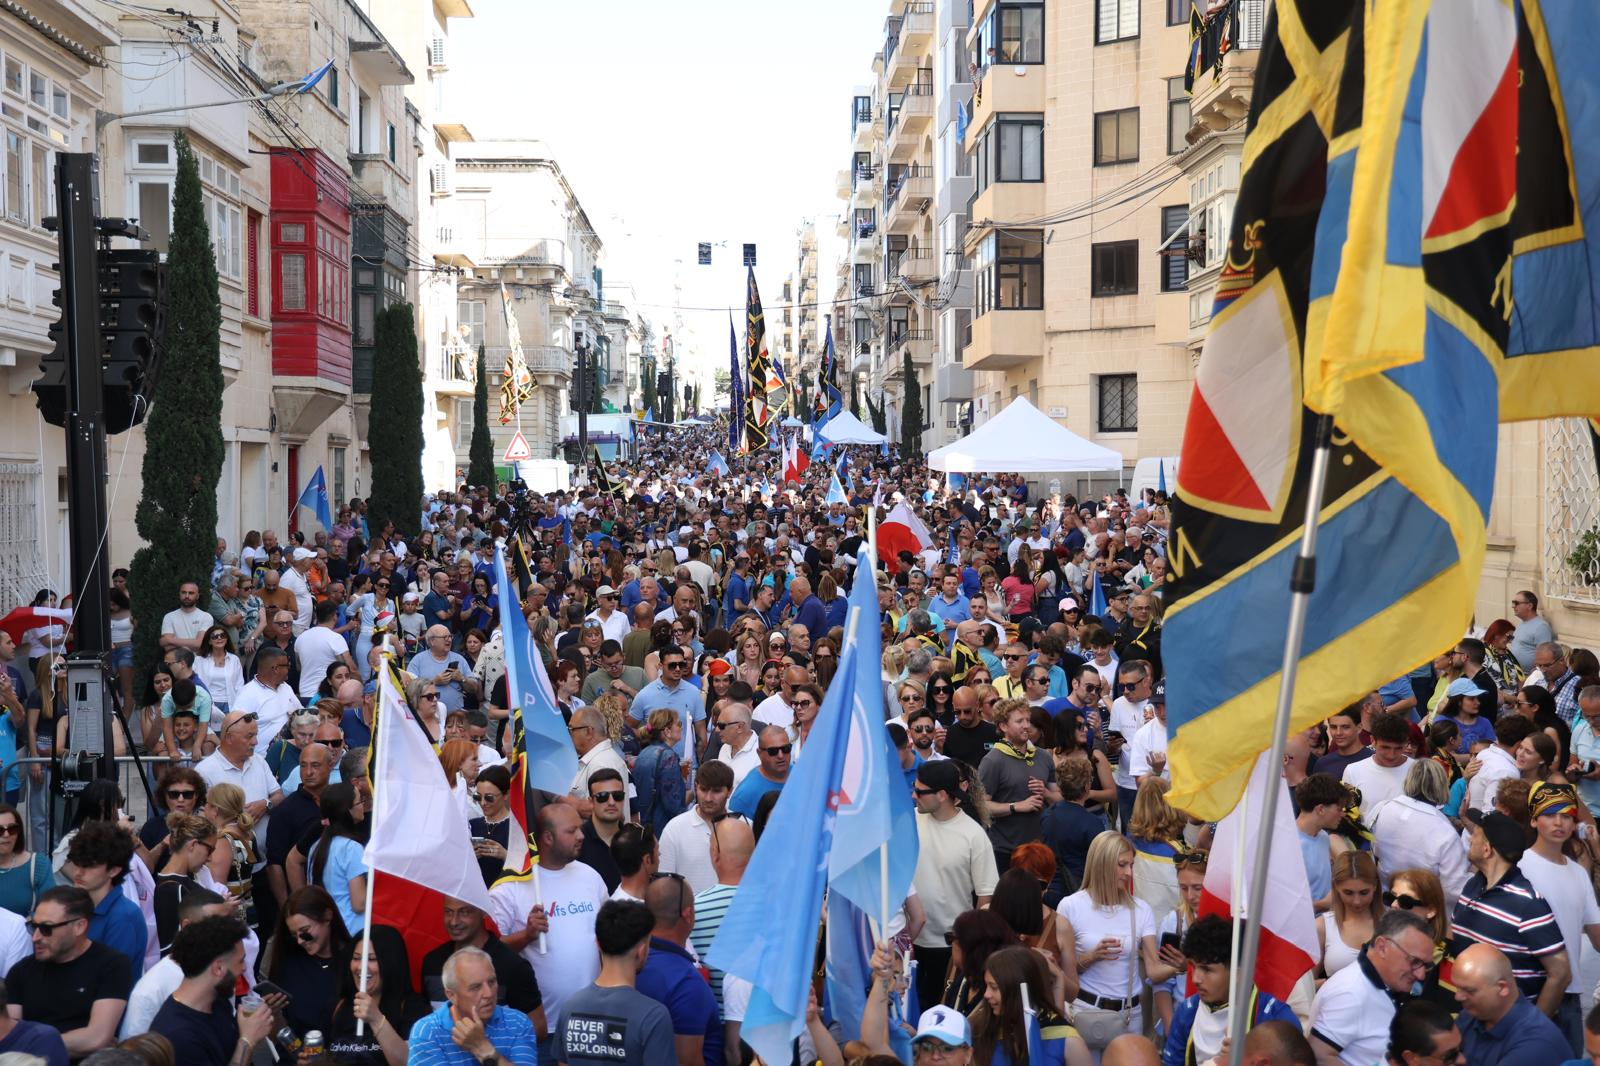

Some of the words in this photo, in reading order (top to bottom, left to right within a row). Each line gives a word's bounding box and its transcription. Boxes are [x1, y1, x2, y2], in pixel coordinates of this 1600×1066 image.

[567, 1019, 604, 1033] NEVER
[566, 1031, 598, 1044] STOP
[566, 1042, 626, 1057] EXPLORING
